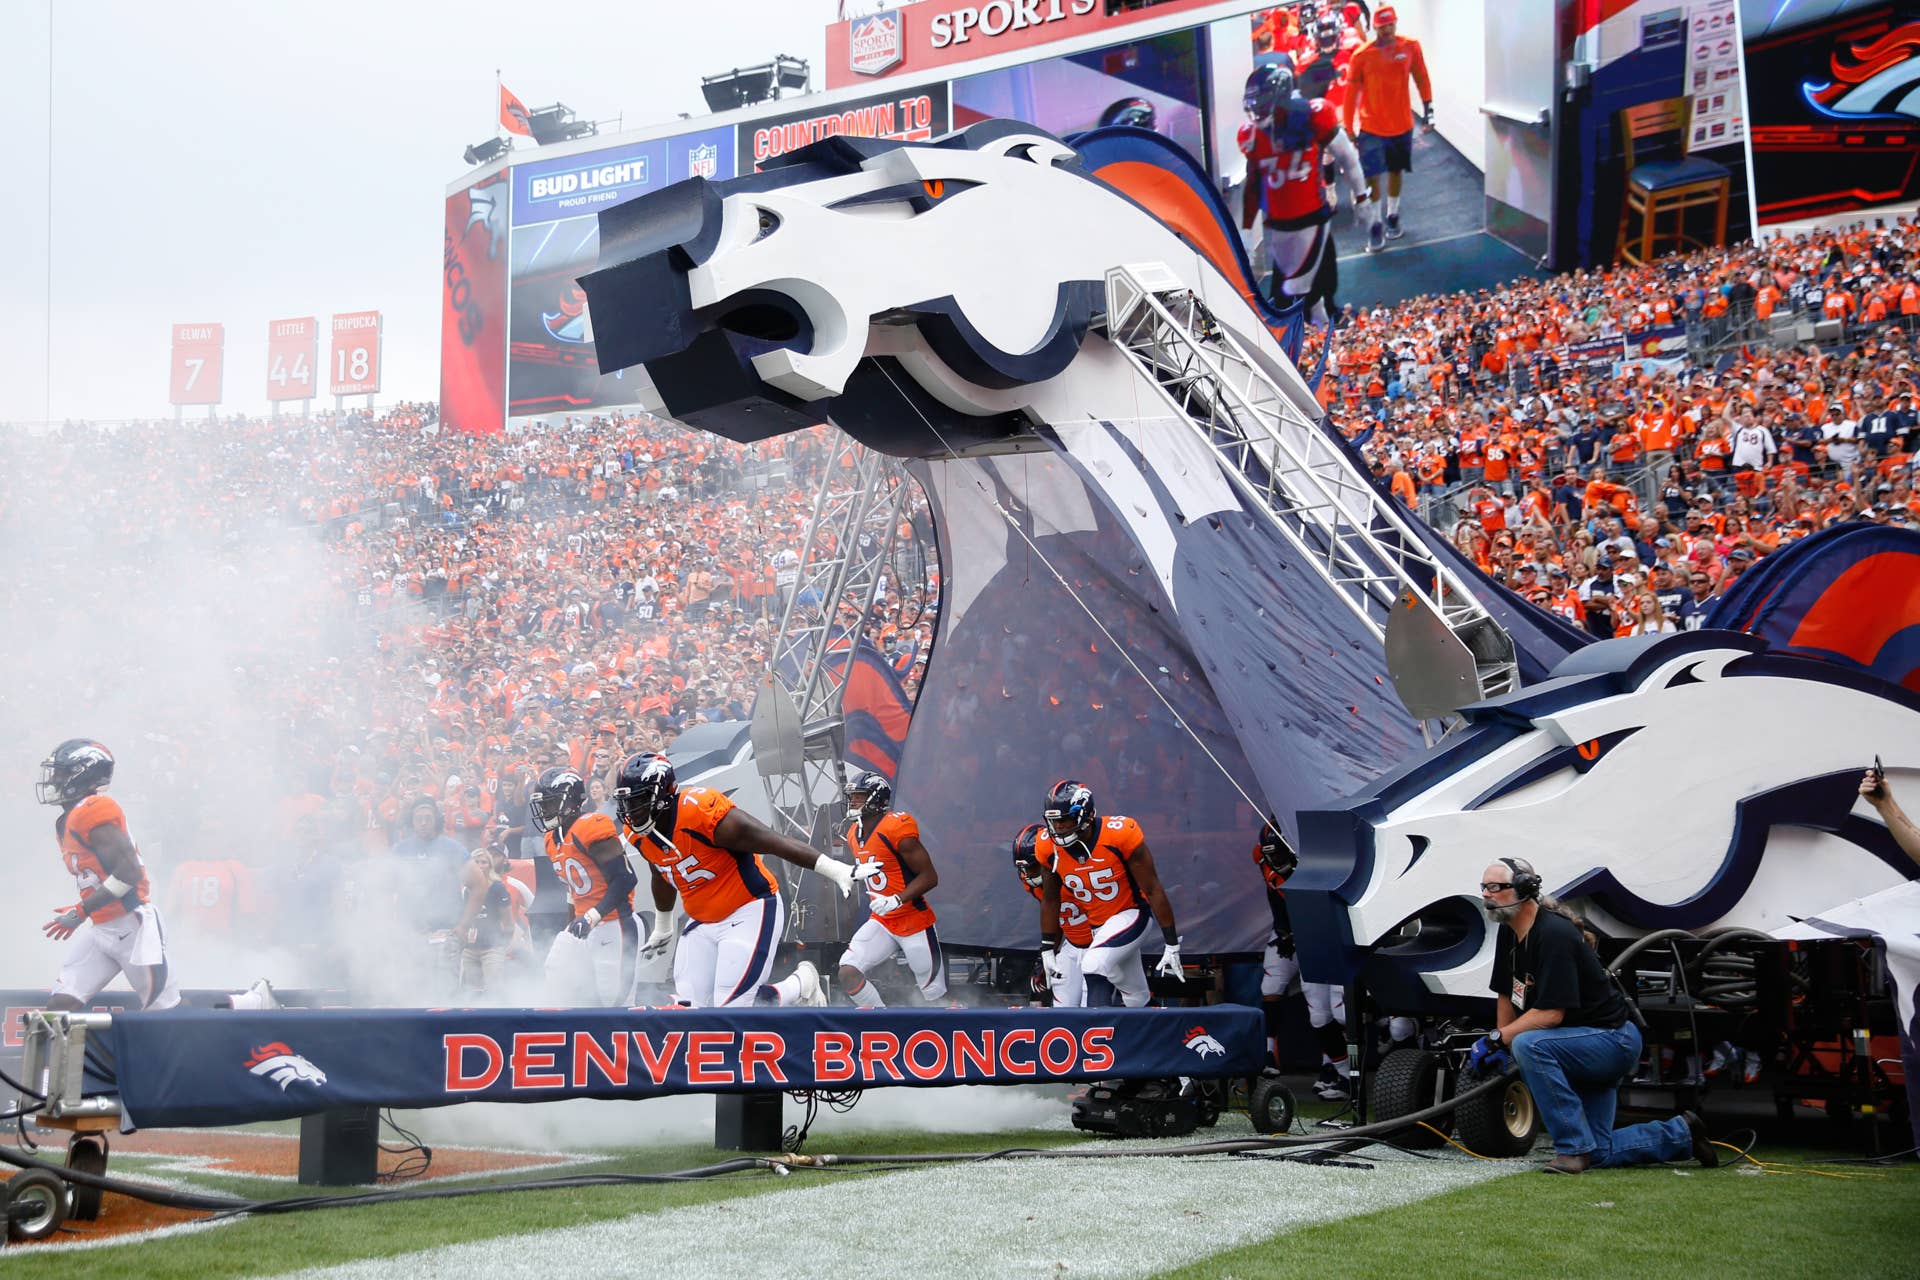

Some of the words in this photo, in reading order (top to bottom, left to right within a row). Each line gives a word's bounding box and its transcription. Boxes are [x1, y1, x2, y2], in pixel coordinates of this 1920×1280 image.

[898, 94, 931, 131] TO
[532, 174, 578, 198] BUD
[580, 160, 644, 189] LIGHT
[692, 158, 714, 177] NFL
[558, 196, 587, 208] PROUD
[588, 191, 617, 204] FRIEND
[180, 327, 213, 341] ELWAY
[277, 322, 305, 337] LITTLE
[333, 315, 377, 331] TRIPUCKA
[183, 358, 205, 392] 7
[268, 352, 310, 387] 44
[337, 347, 369, 382] 18
[1652, 418, 1664, 433] 7
[1870, 417, 1887, 434] 11
[655, 854, 717, 893] 75
[1064, 867, 1119, 902] 85
[191, 874, 220, 908] 18
[443, 1031, 789, 1093] DENVER
[811, 1027, 1116, 1083] BRONCOS
